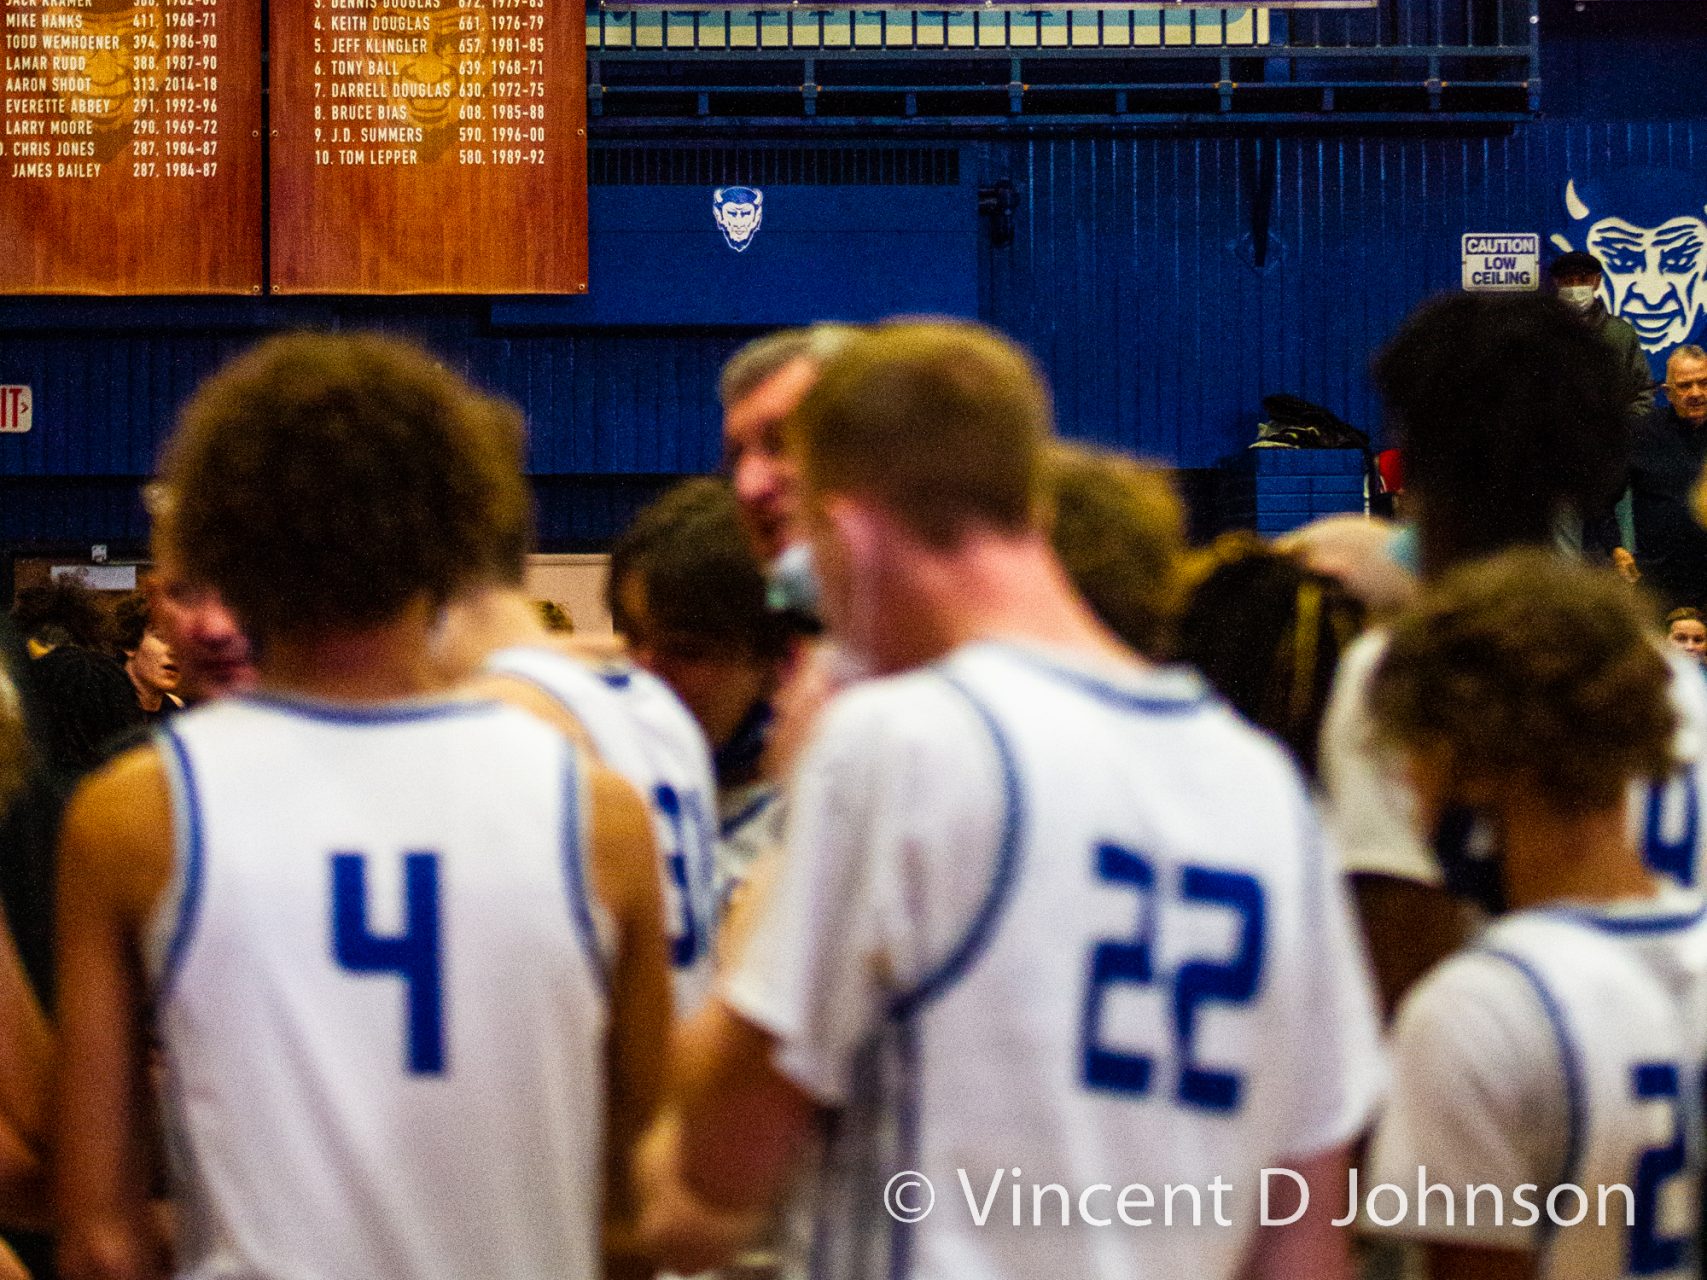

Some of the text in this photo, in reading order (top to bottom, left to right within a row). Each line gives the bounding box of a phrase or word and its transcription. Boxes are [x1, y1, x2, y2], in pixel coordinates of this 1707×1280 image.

[314, 16, 325, 31] 4.
[331, 16, 367, 31] KEITH
[372, 16, 430, 31] DOUGLAS
[491, 15, 544, 31] 1976-79
[6, 120, 45, 135] LARRY
[50, 120, 93, 135] MOORE
[165, 119, 218, 134] 1969-72
[314, 127, 326, 142] 9.
[331, 127, 355, 142] J.D.
[361, 127, 423, 143] SUMMERS
[492, 127, 545, 142] 1996-00
[13, 141, 51, 156] CHRIS
[56, 141, 95, 157] JONES
[165, 141, 218, 156] 1984-87
[315, 150, 334, 165] 10.
[338, 150, 365, 165] TOM
[370, 150, 417, 165] LEPPER
[492, 149, 545, 164] 1989-92
[12, 163, 52, 178] JAMES
[57, 163, 101, 178] BAILEY
[165, 162, 218, 177] 1984-87
[1467, 239, 1533, 253] CAUTION
[1484, 257, 1516, 270] LOW
[1472, 271, 1530, 285] CEILING
[330, 850, 446, 1078] 4
[1076, 840, 1266, 1115] 22
